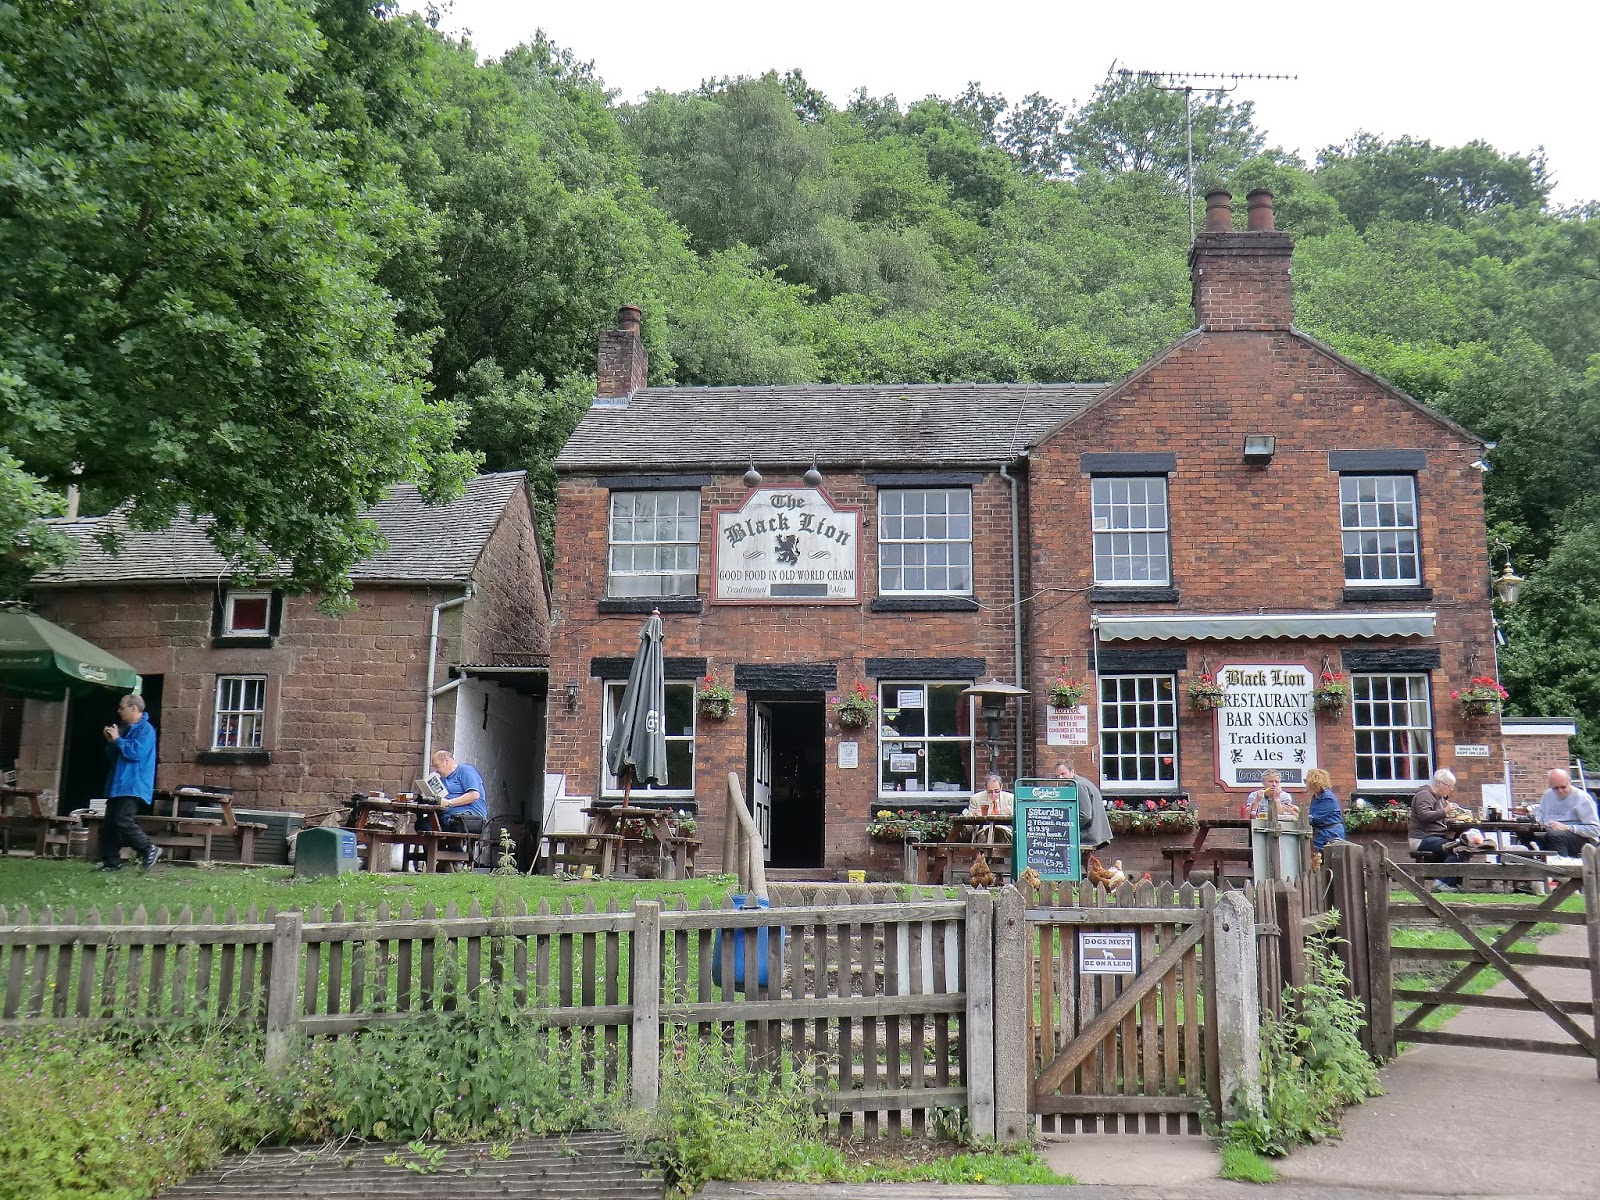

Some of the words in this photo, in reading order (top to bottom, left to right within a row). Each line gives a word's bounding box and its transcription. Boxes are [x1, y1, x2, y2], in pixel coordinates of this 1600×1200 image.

[770, 494, 805, 511] The
[724, 512, 790, 548] Black
[798, 513, 851, 546] Lion
[719, 570, 742, 581] GOOD
[744, 570, 766, 581] FOOD
[768, 570, 777, 581] IN
[779, 570, 795, 581] OLD
[797, 570, 825, 581] WORLD
[827, 570, 855, 581] CHARM
[726, 585, 767, 594] Traditional
[1225, 669, 1267, 688] Black
[1271, 669, 1305, 686] Lion
[1222, 692, 1308, 708] RESTAURANT
[1225, 711, 1253, 727] BAR
[1258, 711, 1309, 727] SNACKS
[1228, 732, 1308, 744] Traditional
[1253, 748, 1283, 761] Ales
[1032, 787, 1061, 799] Carlsberg
[1028, 808, 1064, 819] Saturday
